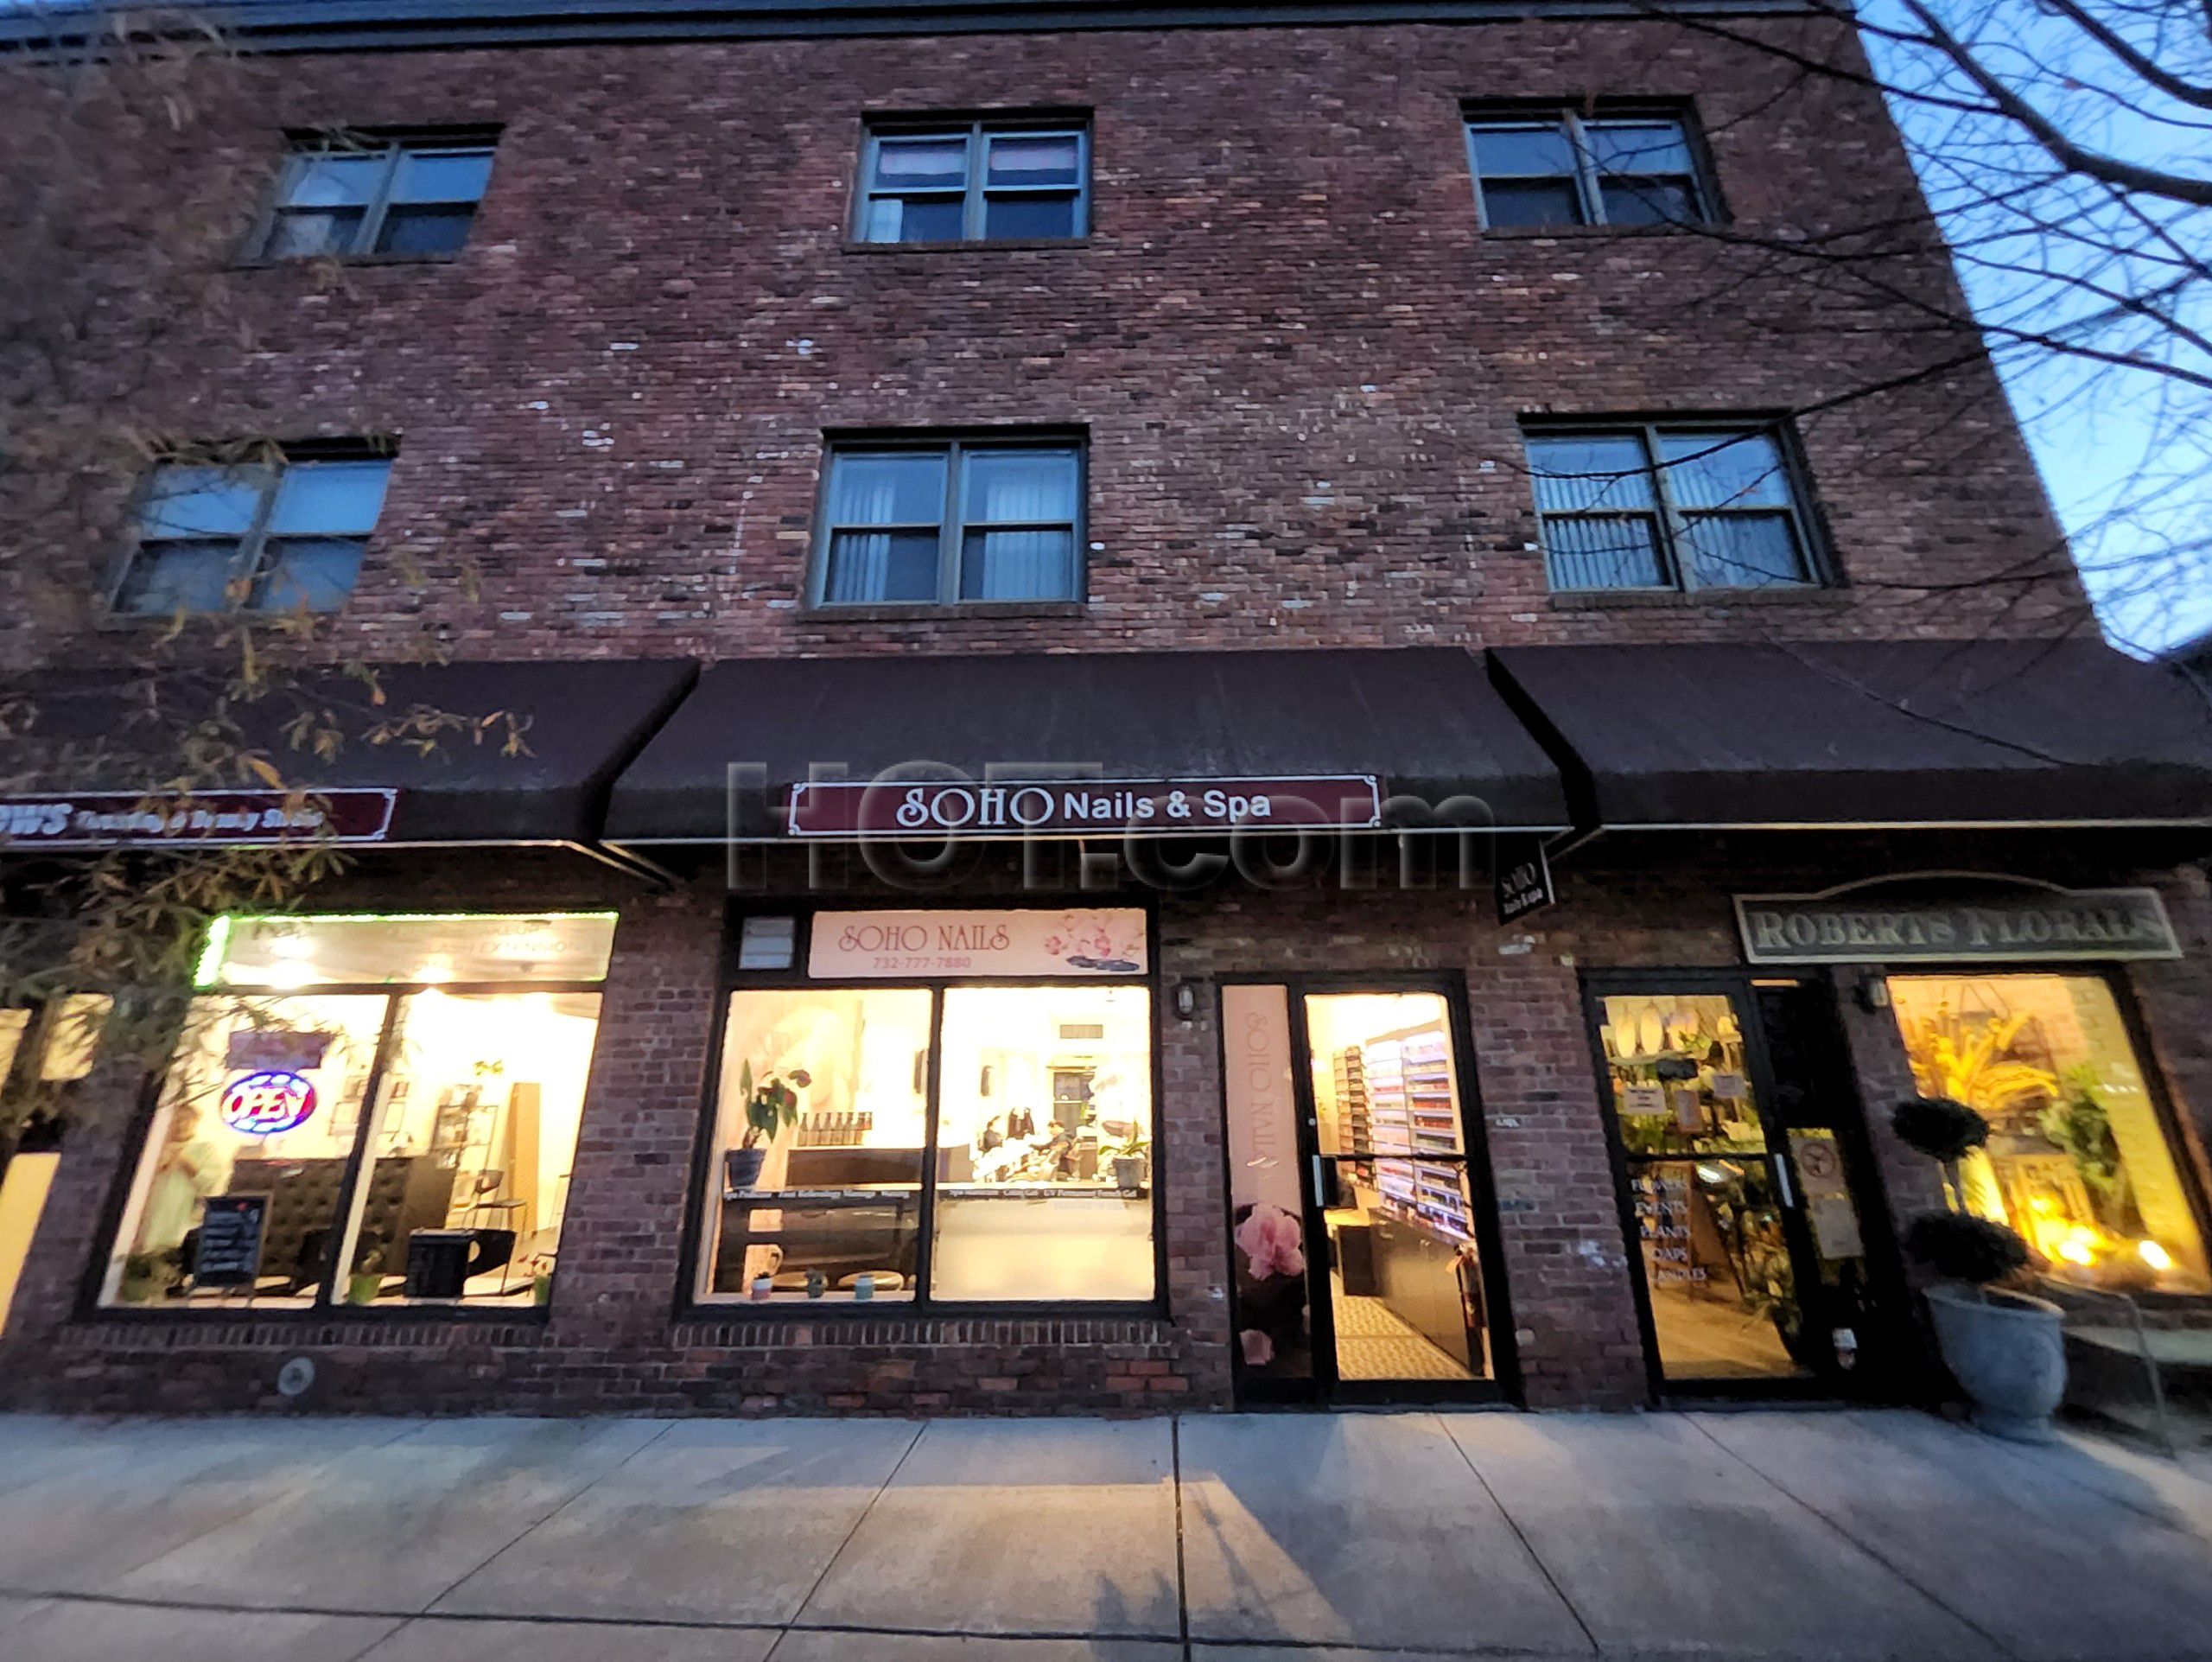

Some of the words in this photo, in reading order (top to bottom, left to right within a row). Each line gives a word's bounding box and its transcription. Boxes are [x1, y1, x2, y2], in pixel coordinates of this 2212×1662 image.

[896, 787, 1054, 827] SOHO
[1064, 792, 1154, 819] Nails
[1166, 790, 1190, 818] &
[1203, 789, 1271, 823] Spa
[838, 926, 929, 952] SOHO
[938, 924, 1010, 951] NAILS
[1748, 912, 1956, 949] ROBERTS
[1244, 1011, 1272, 1092] SOHO
[221, 1087, 306, 1121] OPEN
